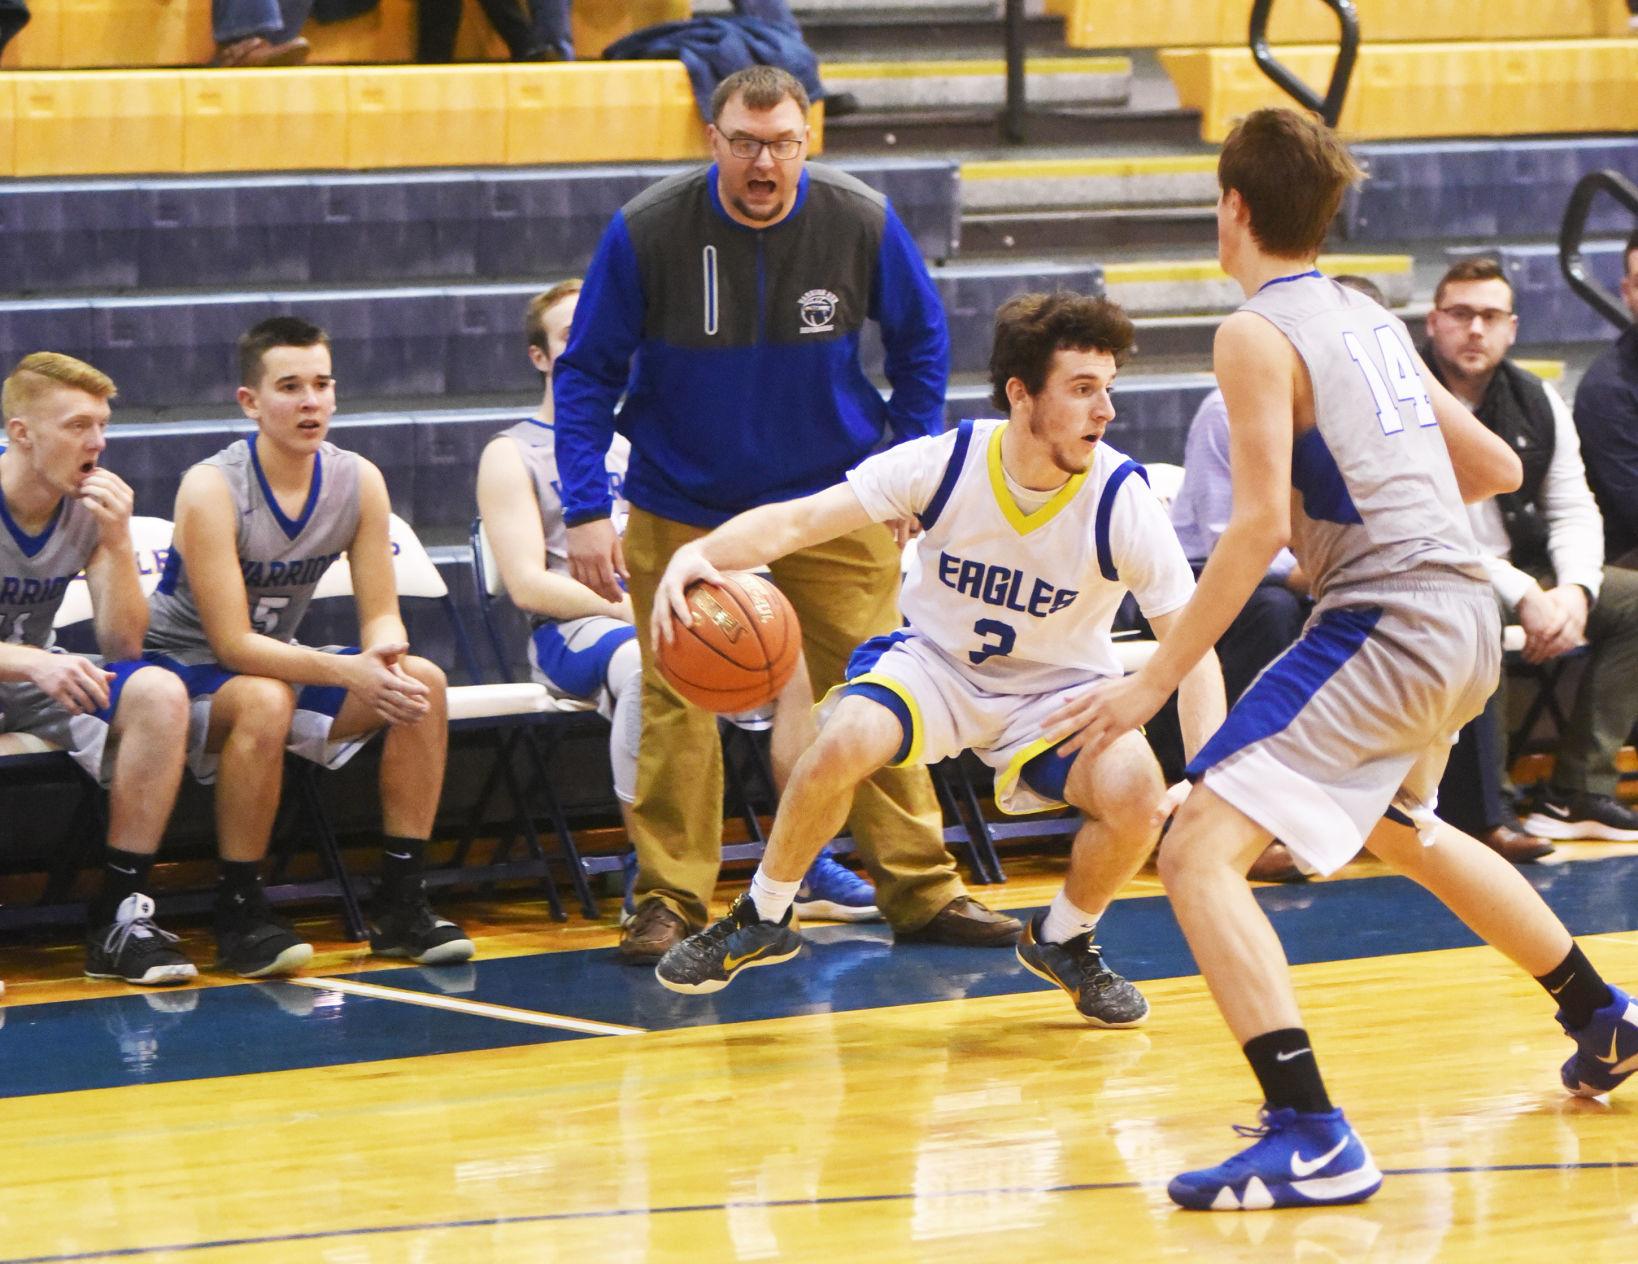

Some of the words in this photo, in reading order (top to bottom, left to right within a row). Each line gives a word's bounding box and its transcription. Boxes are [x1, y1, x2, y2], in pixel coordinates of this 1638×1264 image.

[1342, 325, 1438, 436] 14
[938, 550, 1080, 618] EAGLES
[251, 595, 291, 634] 5
[968, 617, 1017, 665] 3
